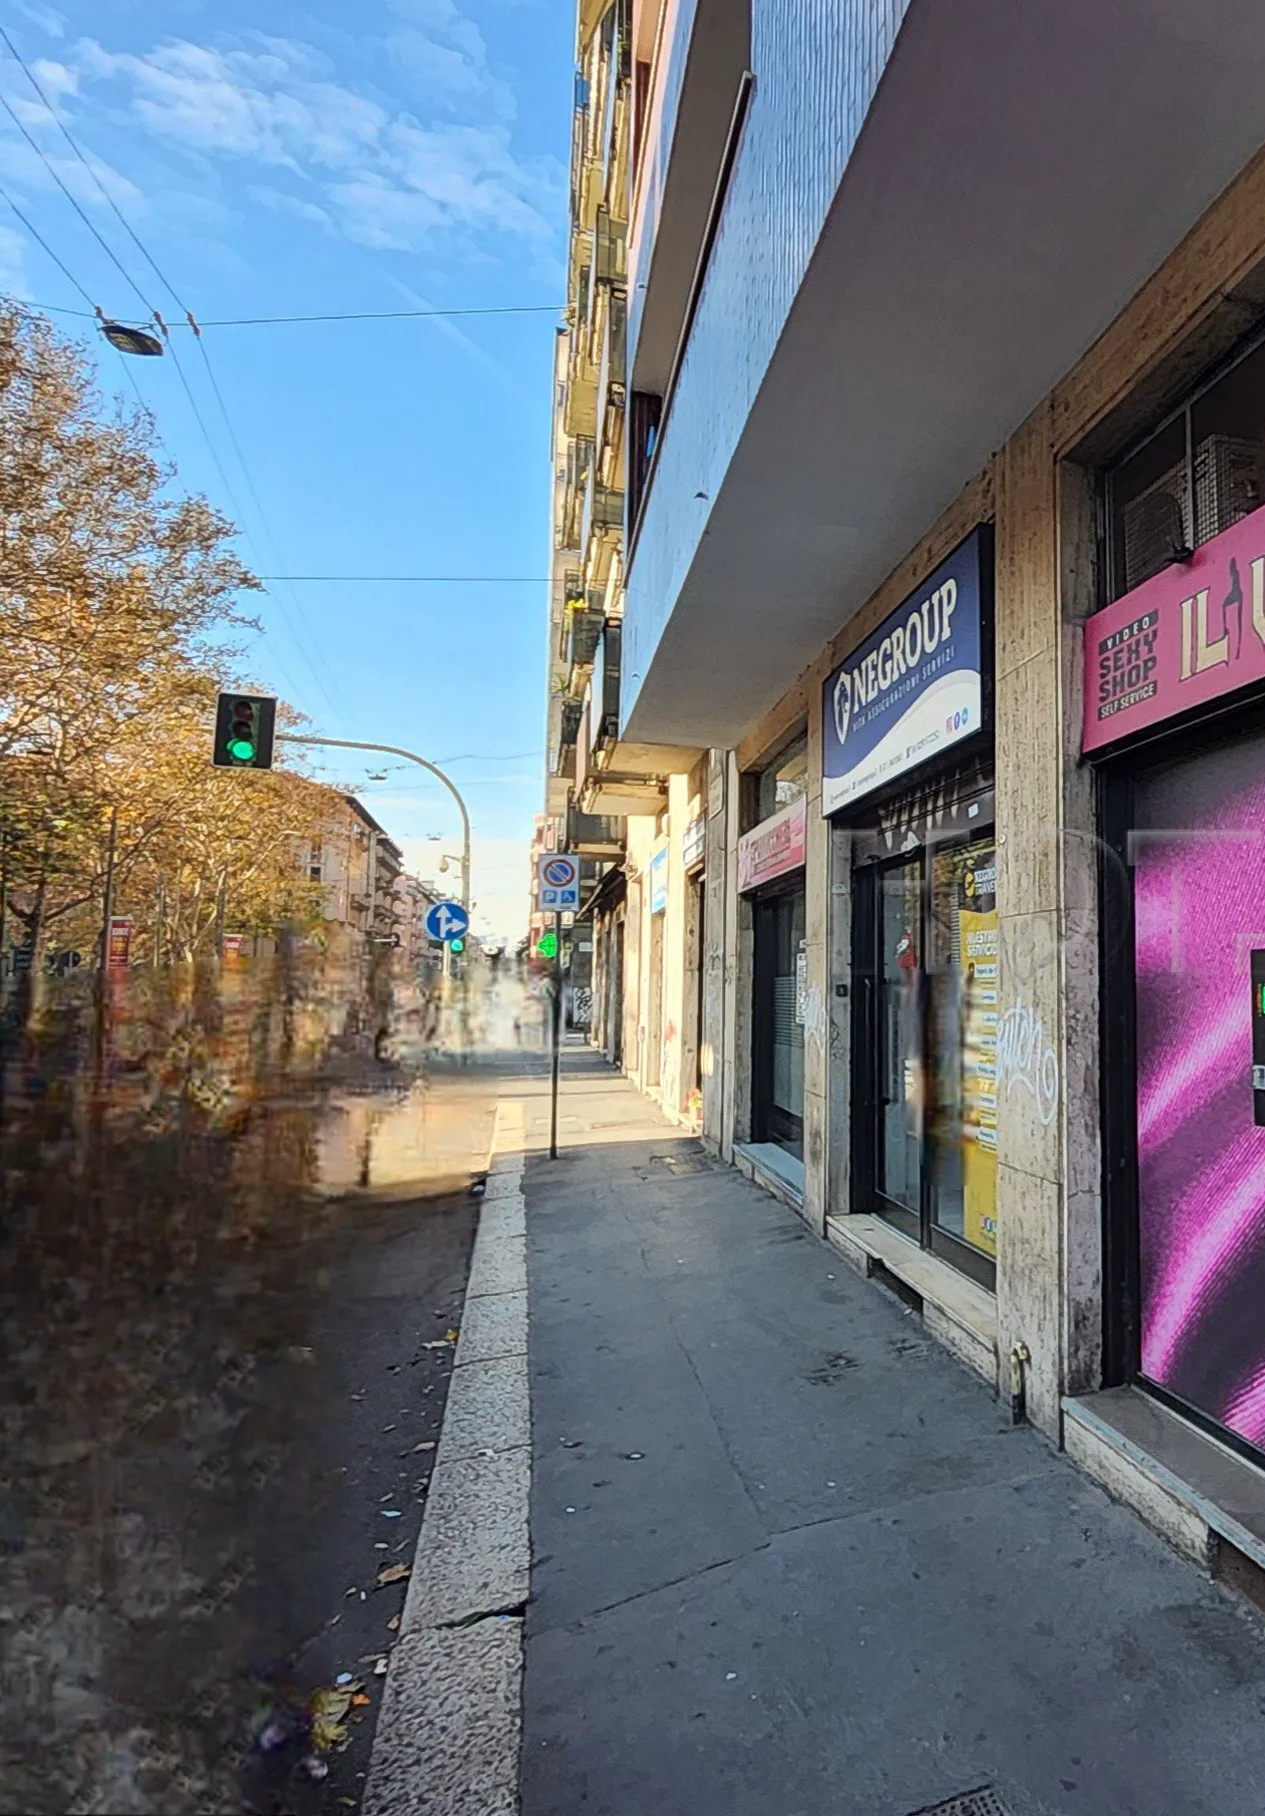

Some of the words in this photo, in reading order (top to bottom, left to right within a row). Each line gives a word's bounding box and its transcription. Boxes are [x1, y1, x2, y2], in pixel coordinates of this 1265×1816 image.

[1098, 627, 1159, 680] SEXY
[1106, 616, 1150, 650] VIDEO
[1179, 587, 1230, 683] IL
[1098, 655, 1158, 704] SHOP
[1100, 699, 1119, 719] SELF
[1120, 683, 1155, 710] SERVICE
